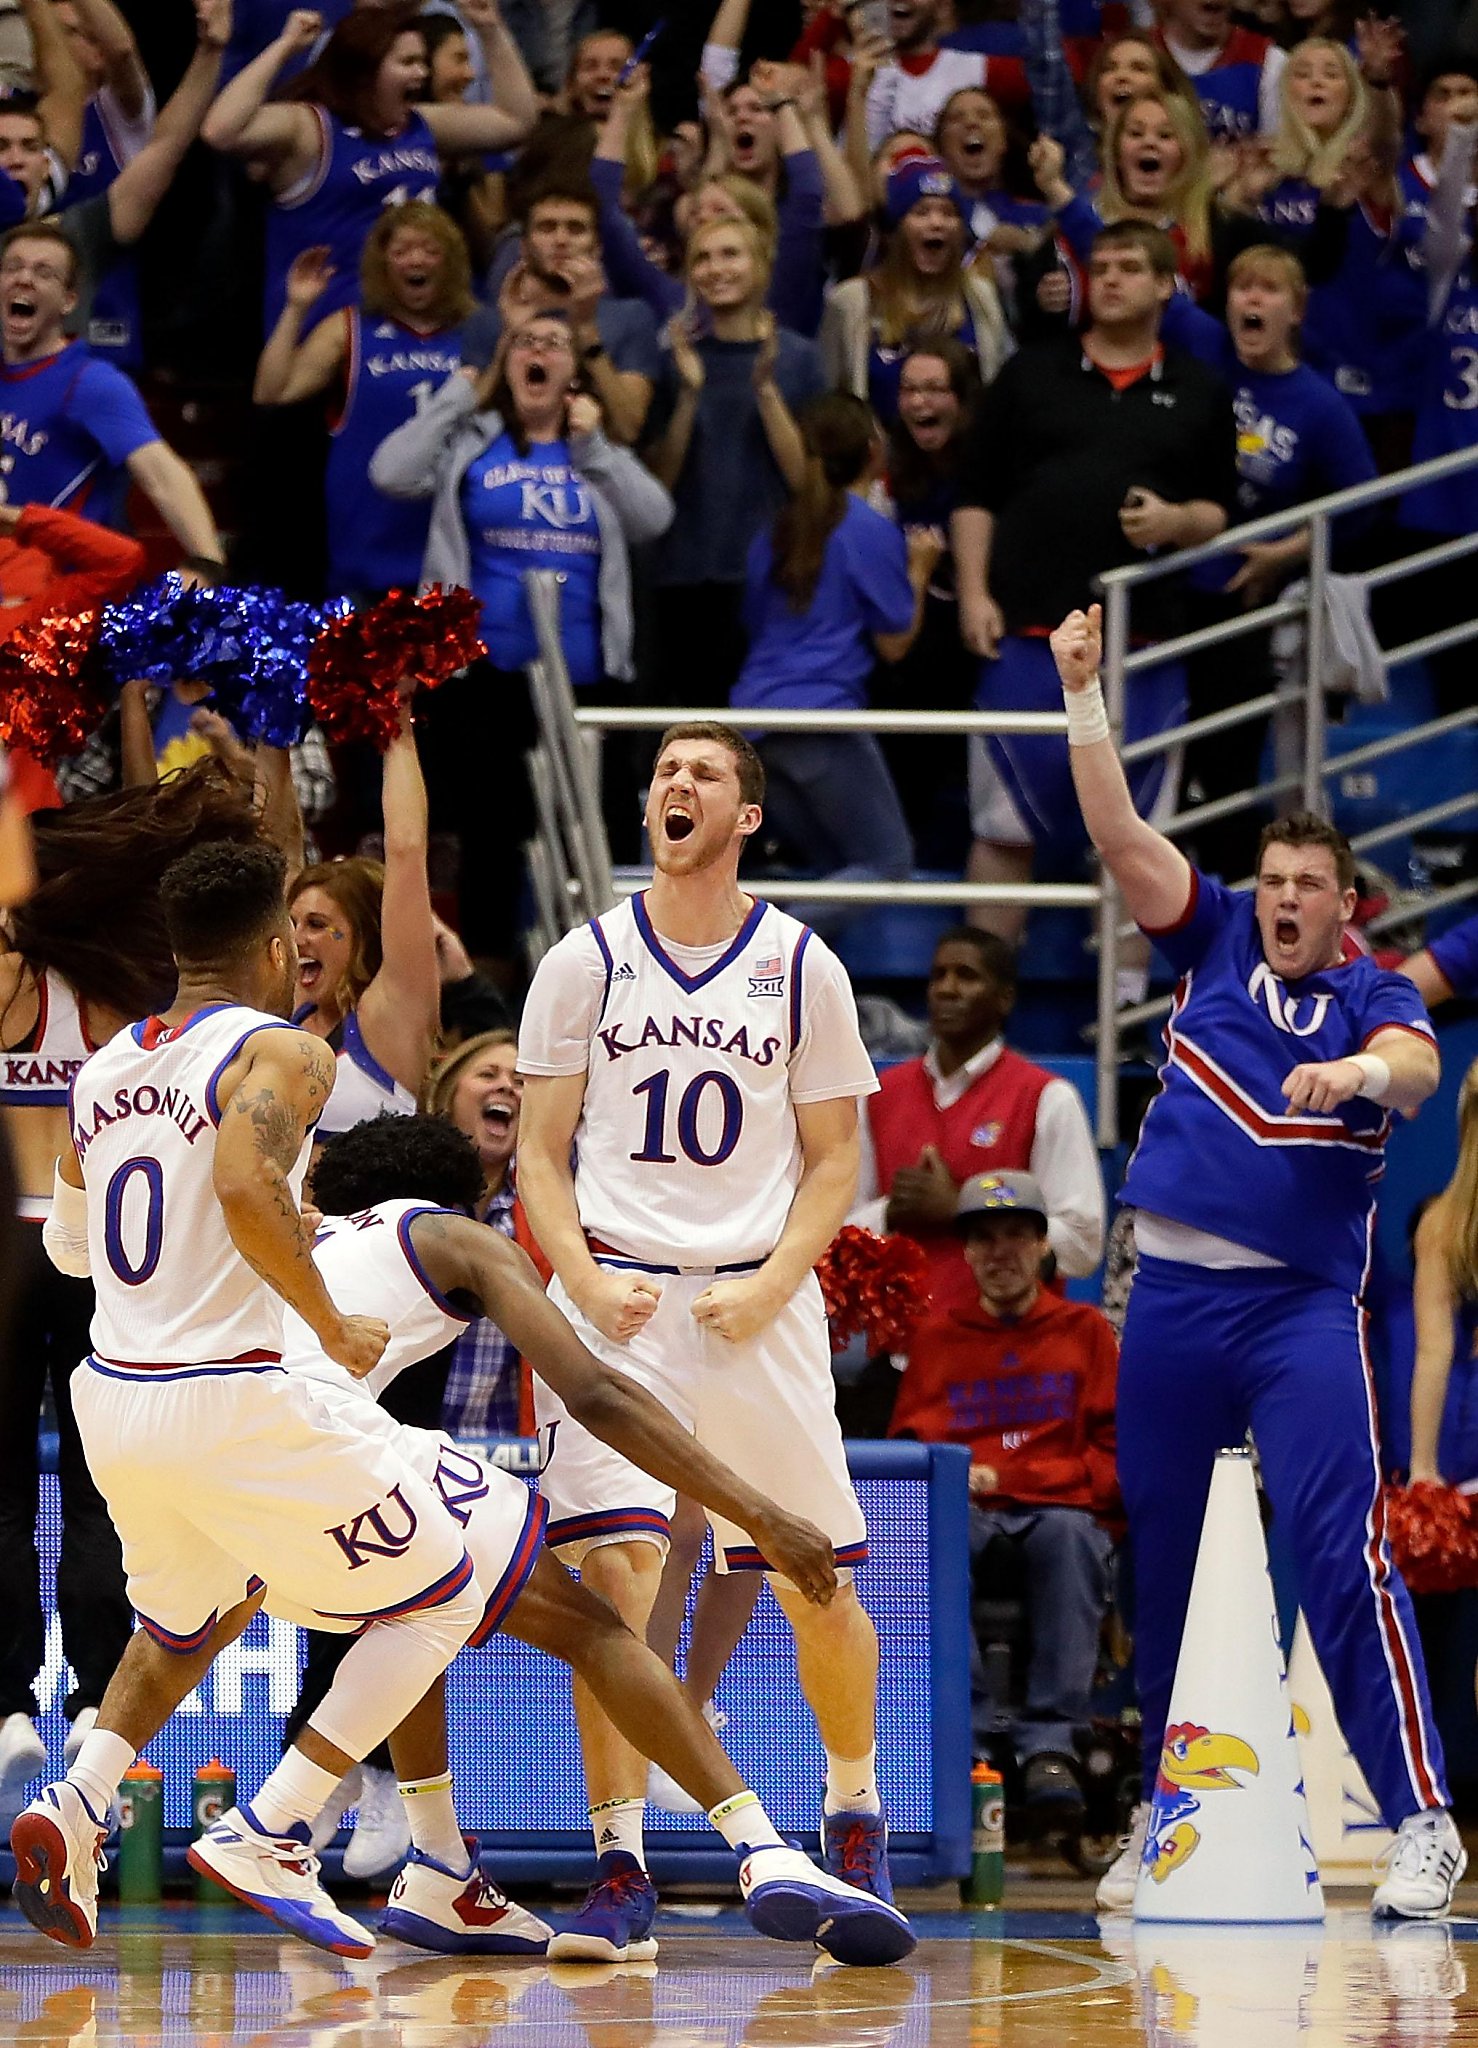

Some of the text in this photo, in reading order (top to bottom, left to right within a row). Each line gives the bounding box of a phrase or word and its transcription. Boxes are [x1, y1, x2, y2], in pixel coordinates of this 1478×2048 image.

[519, 479, 592, 530] KU
[597, 1015, 782, 1067] KANSAS
[630, 1068, 744, 1167] 10
[104, 1155, 164, 1287] 0
[324, 1482, 418, 1570] KU
[433, 1443, 490, 1530] KU
